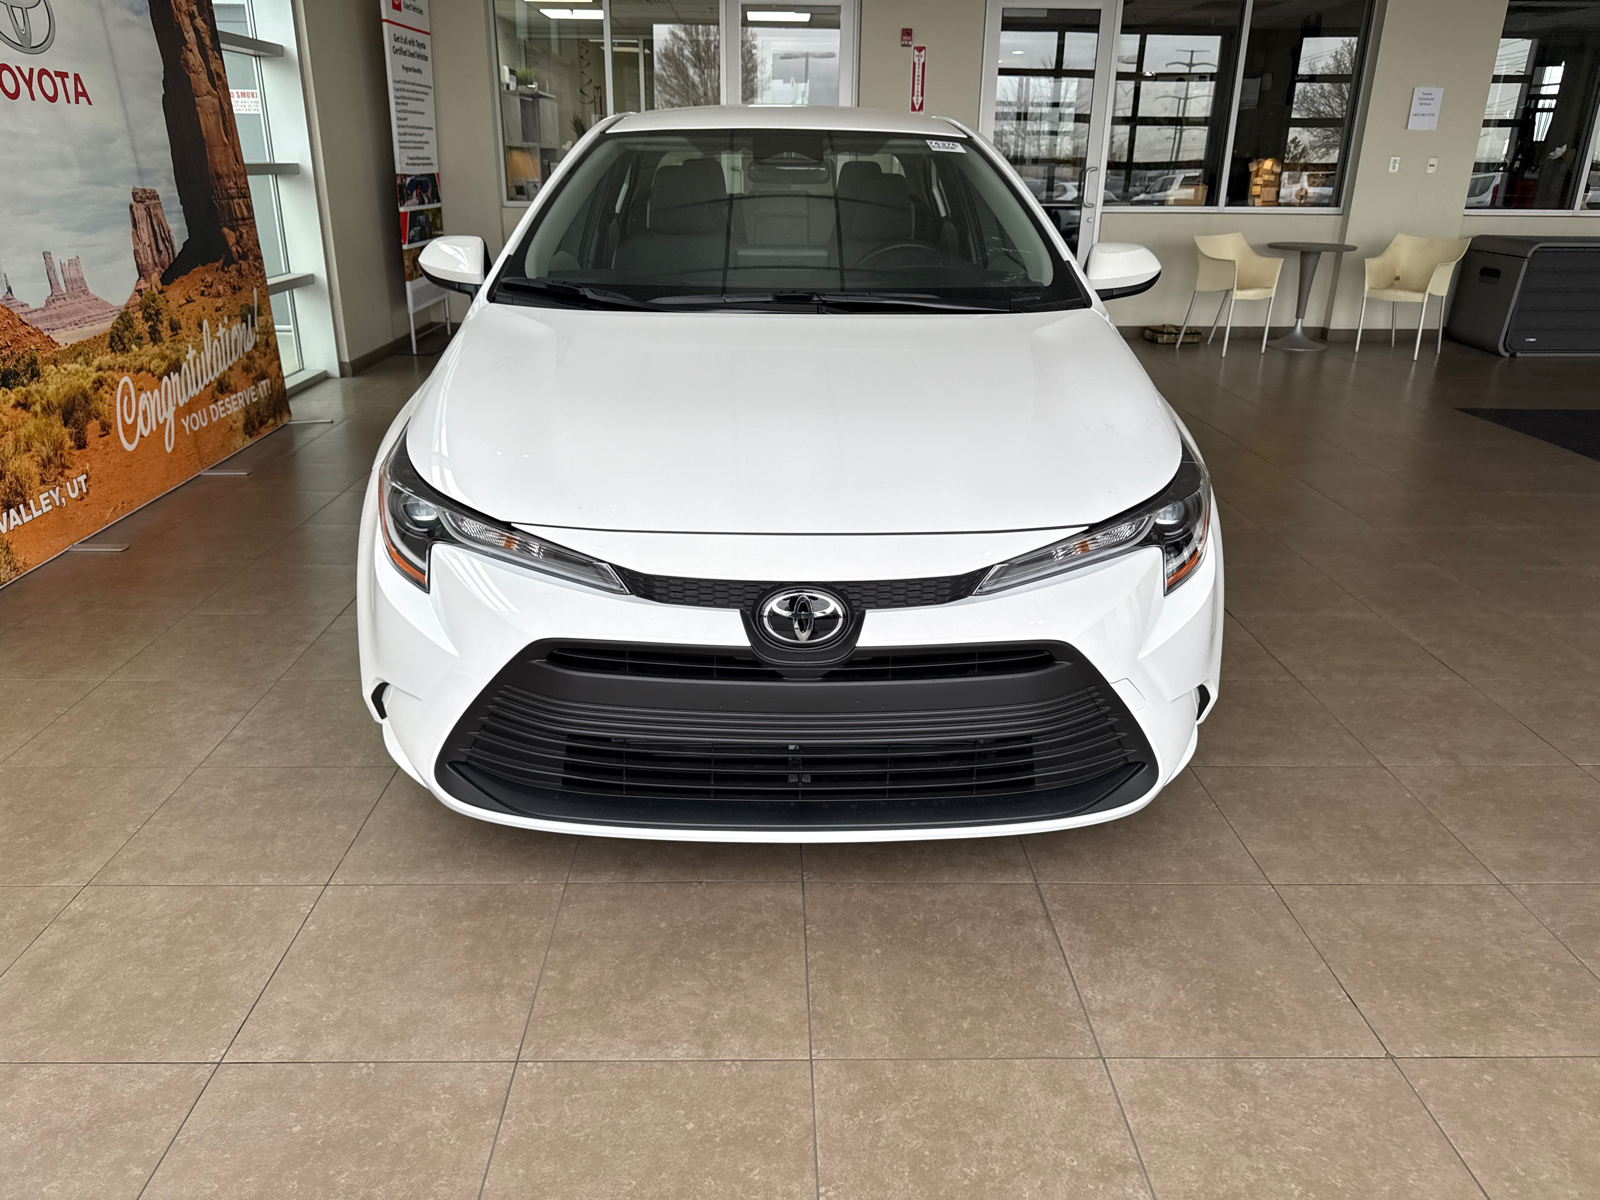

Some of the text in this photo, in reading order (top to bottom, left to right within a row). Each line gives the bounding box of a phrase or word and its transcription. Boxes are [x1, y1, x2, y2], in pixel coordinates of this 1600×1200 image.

[0, 63, 93, 106] OYOTA
[116, 287, 259, 453] Congratulations!
[181, 378, 272, 435] YOU DESERVE IT!
[0, 474, 87, 534] VALLEY, UT
